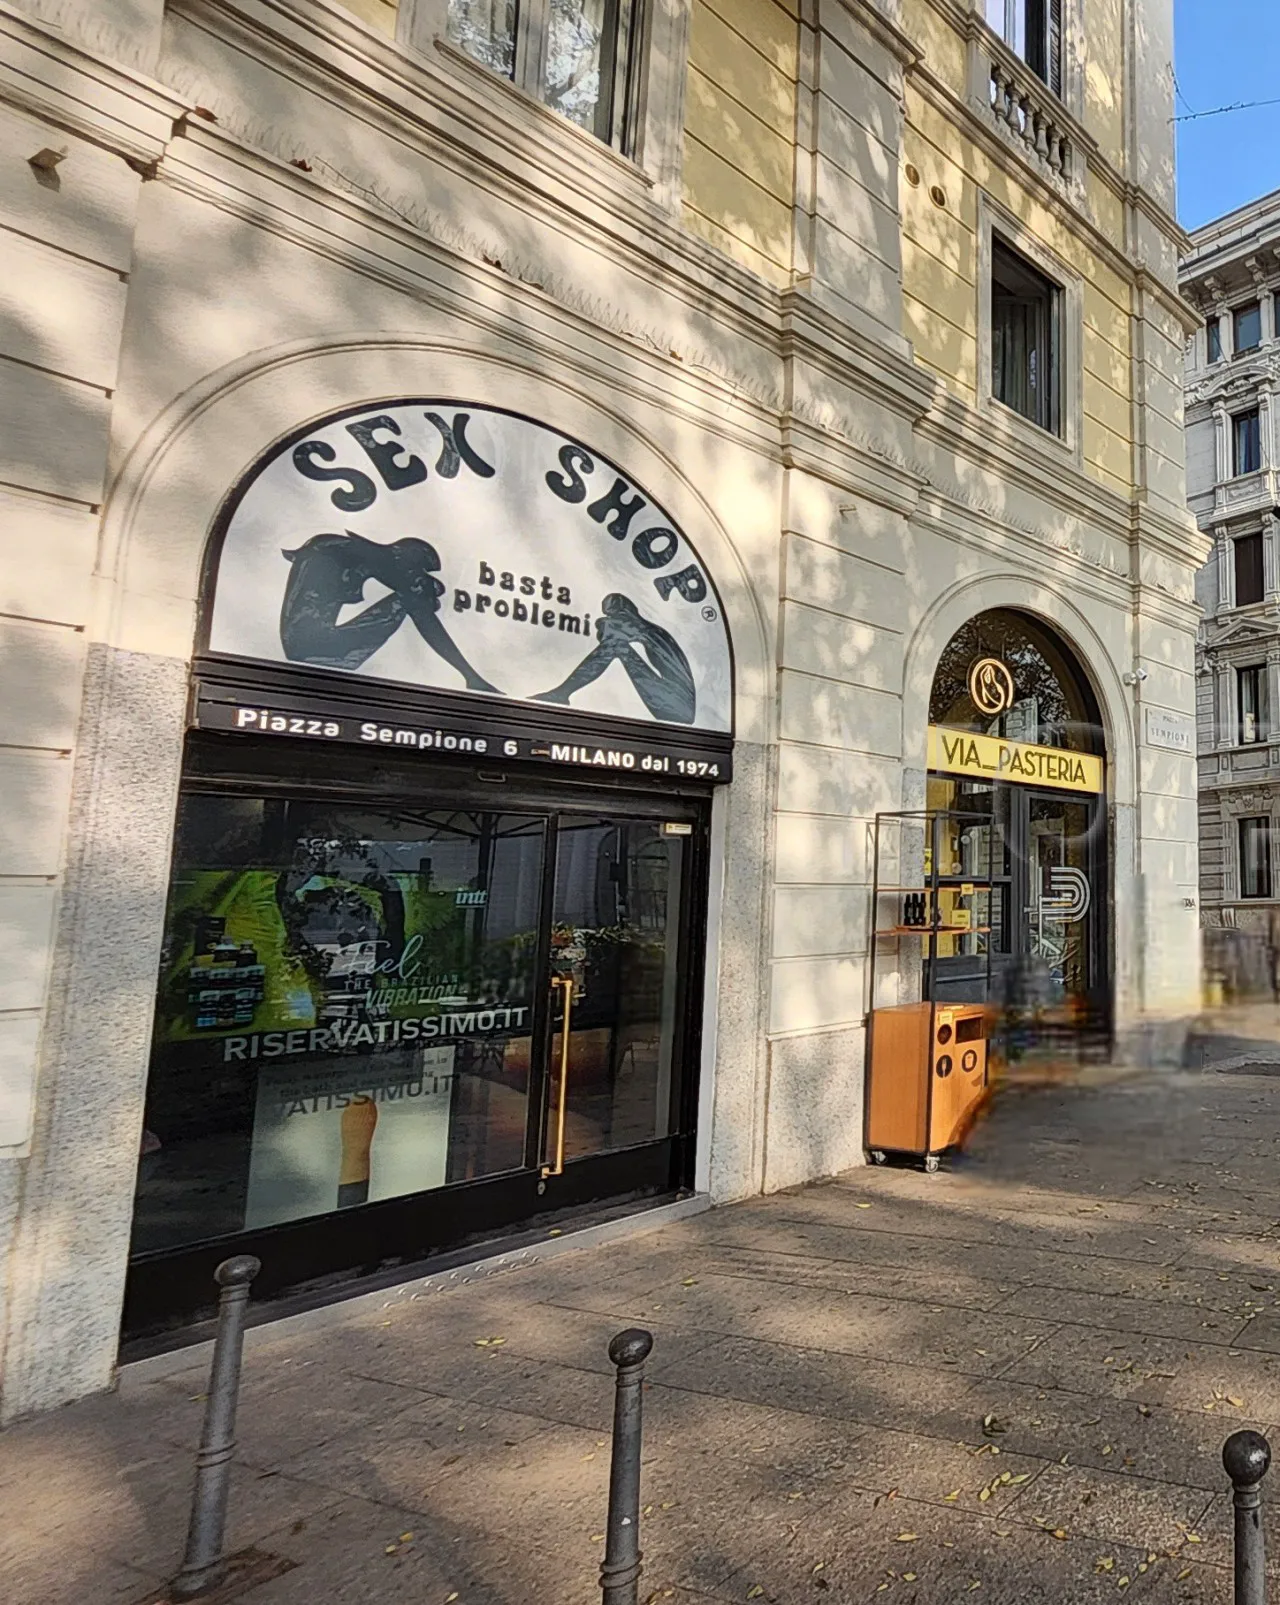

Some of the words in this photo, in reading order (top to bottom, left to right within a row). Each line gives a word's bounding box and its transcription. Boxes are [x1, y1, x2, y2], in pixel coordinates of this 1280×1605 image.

[292, 411, 496, 512] SEX
[545, 445, 708, 604] SHOP
[479, 560, 571, 606] basta
[453, 588, 591, 637] problemi
[236, 708, 340, 737] Piazza
[360, 722, 487, 752] Sempione
[503, 740, 518, 756] 6
[641, 755, 669, 772] dal
[676, 760, 720, 777] 1974
[341, 934, 424, 980] Feel
[344, 978, 372, 991] THE
[381, 973, 459, 989] BRAZILIAN
[222, 1006, 530, 1063] RISERVATISSIMO.IT
